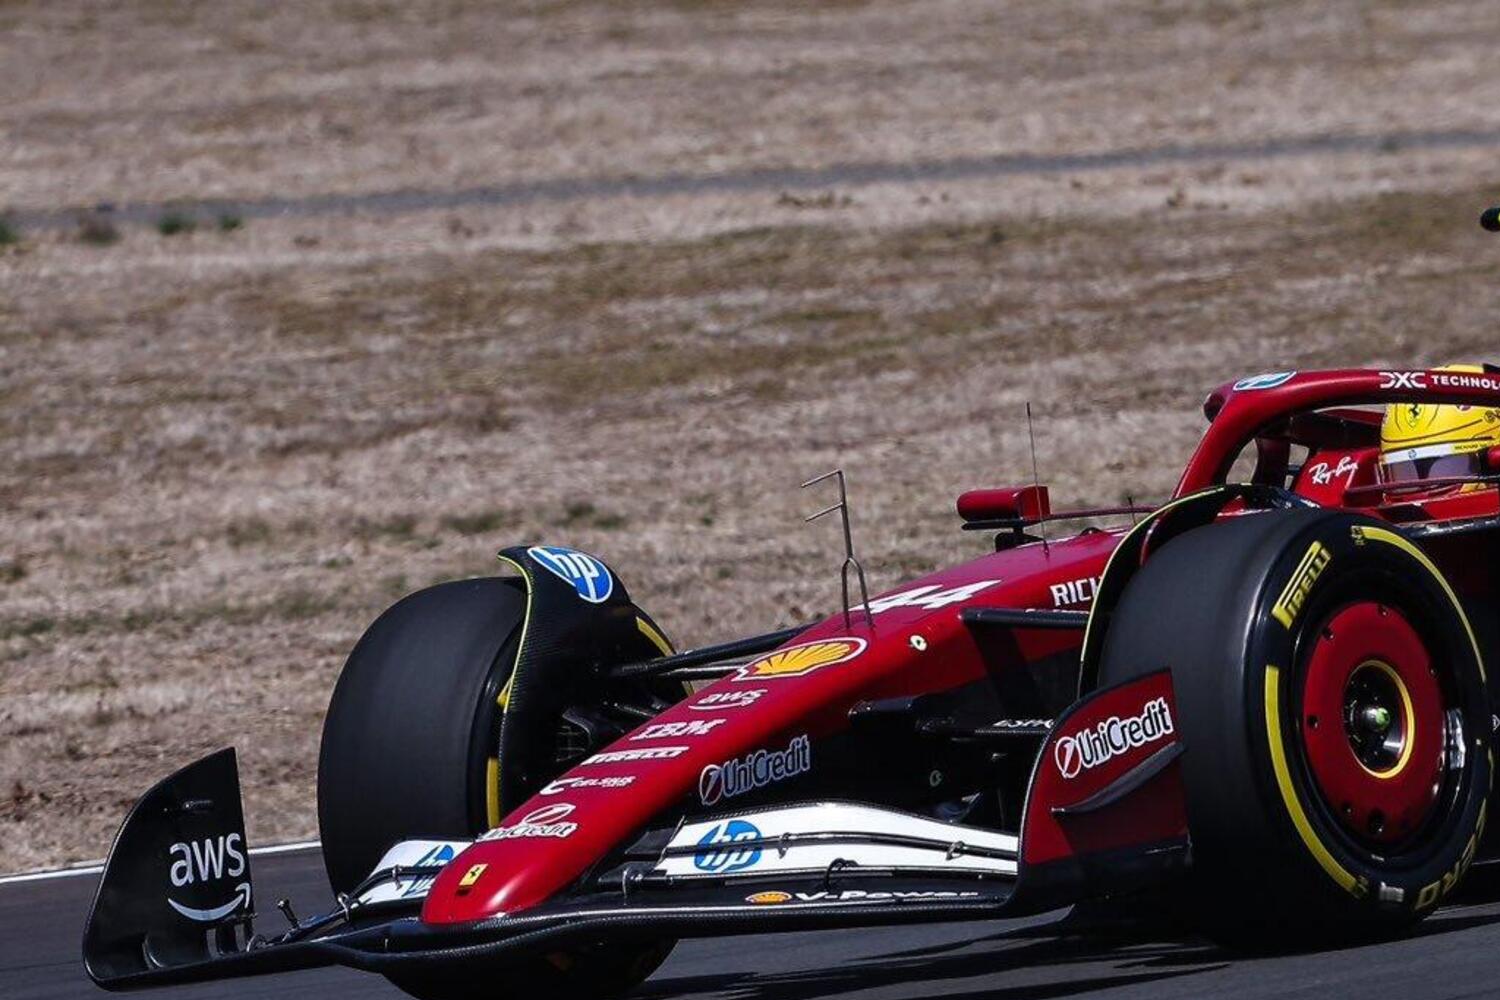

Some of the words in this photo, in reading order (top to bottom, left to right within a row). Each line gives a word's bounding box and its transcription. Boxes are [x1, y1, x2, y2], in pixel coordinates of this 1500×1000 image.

[1379, 371, 1426, 389] DXC
[530, 546, 603, 602] hp
[1271, 540, 1332, 630] PIRELLI
[697, 690, 768, 704] aws
[629, 719, 726, 741] IBM
[1076, 697, 1174, 768] UniCredit
[722, 734, 811, 798] UniCredit
[169, 832, 245, 887] aws
